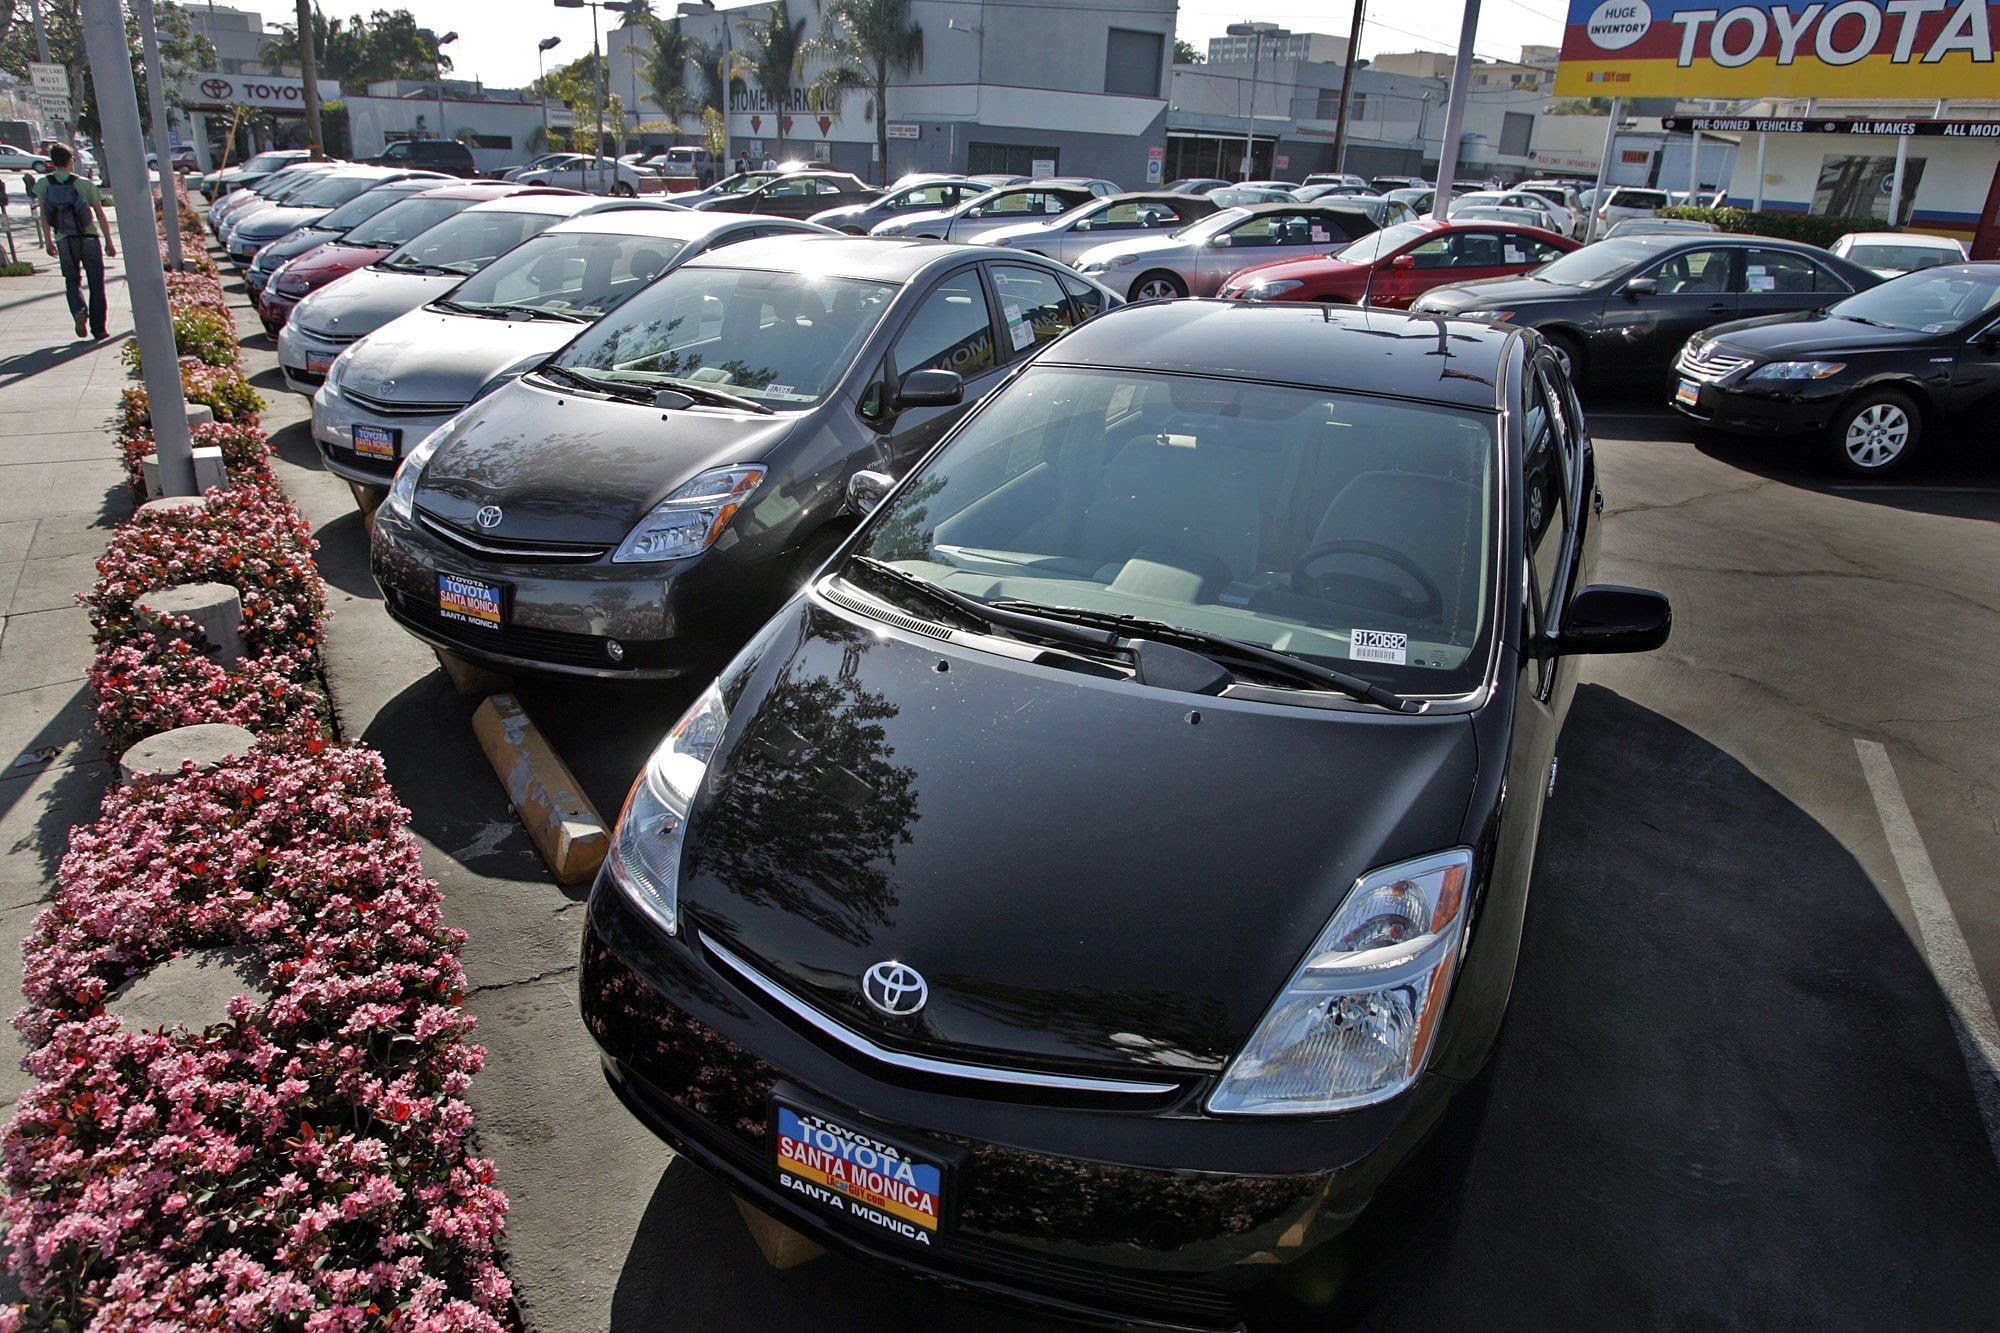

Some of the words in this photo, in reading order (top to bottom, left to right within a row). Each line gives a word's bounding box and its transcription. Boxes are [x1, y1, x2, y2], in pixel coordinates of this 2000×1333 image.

[1605, 7, 1637, 19] HUGE
[1590, 23, 1646, 35] INVENTORY
[1671, 0, 1995, 68] TOYOTA
[40, 76, 60, 84] MUST
[243, 83, 322, 102] TOYOT
[1692, 119, 1750, 131] PRE-OWNED
[1756, 120, 1804, 132] VEHICLES
[1850, 122, 1871, 134] ALL
[1873, 123, 1916, 135] MAKES
[1944, 124, 1967, 136] ALL
[359, 430, 388, 441] TOYOTA
[446, 580, 491, 601] TOYOTA
[449, 575, 484, 588] TOYOTA
[440, 590, 466, 606] SANTA
[467, 597, 499, 614] MONICA
[440, 610, 466, 621] SANTA
[468, 616, 499, 630] MONICA
[1354, 631, 1406, 650] 9120682
[811, 1116, 899, 1159] TOYOTA
[798, 1119, 916, 1187] TOYOTA
[781, 1136, 846, 1180] SANTA
[852, 1165, 934, 1216] MONICA
[826, 1174, 885, 1207] LAcarGUY.com
[780, 1173, 844, 1209] SANTA
[851, 1202, 930, 1246] MONICA
